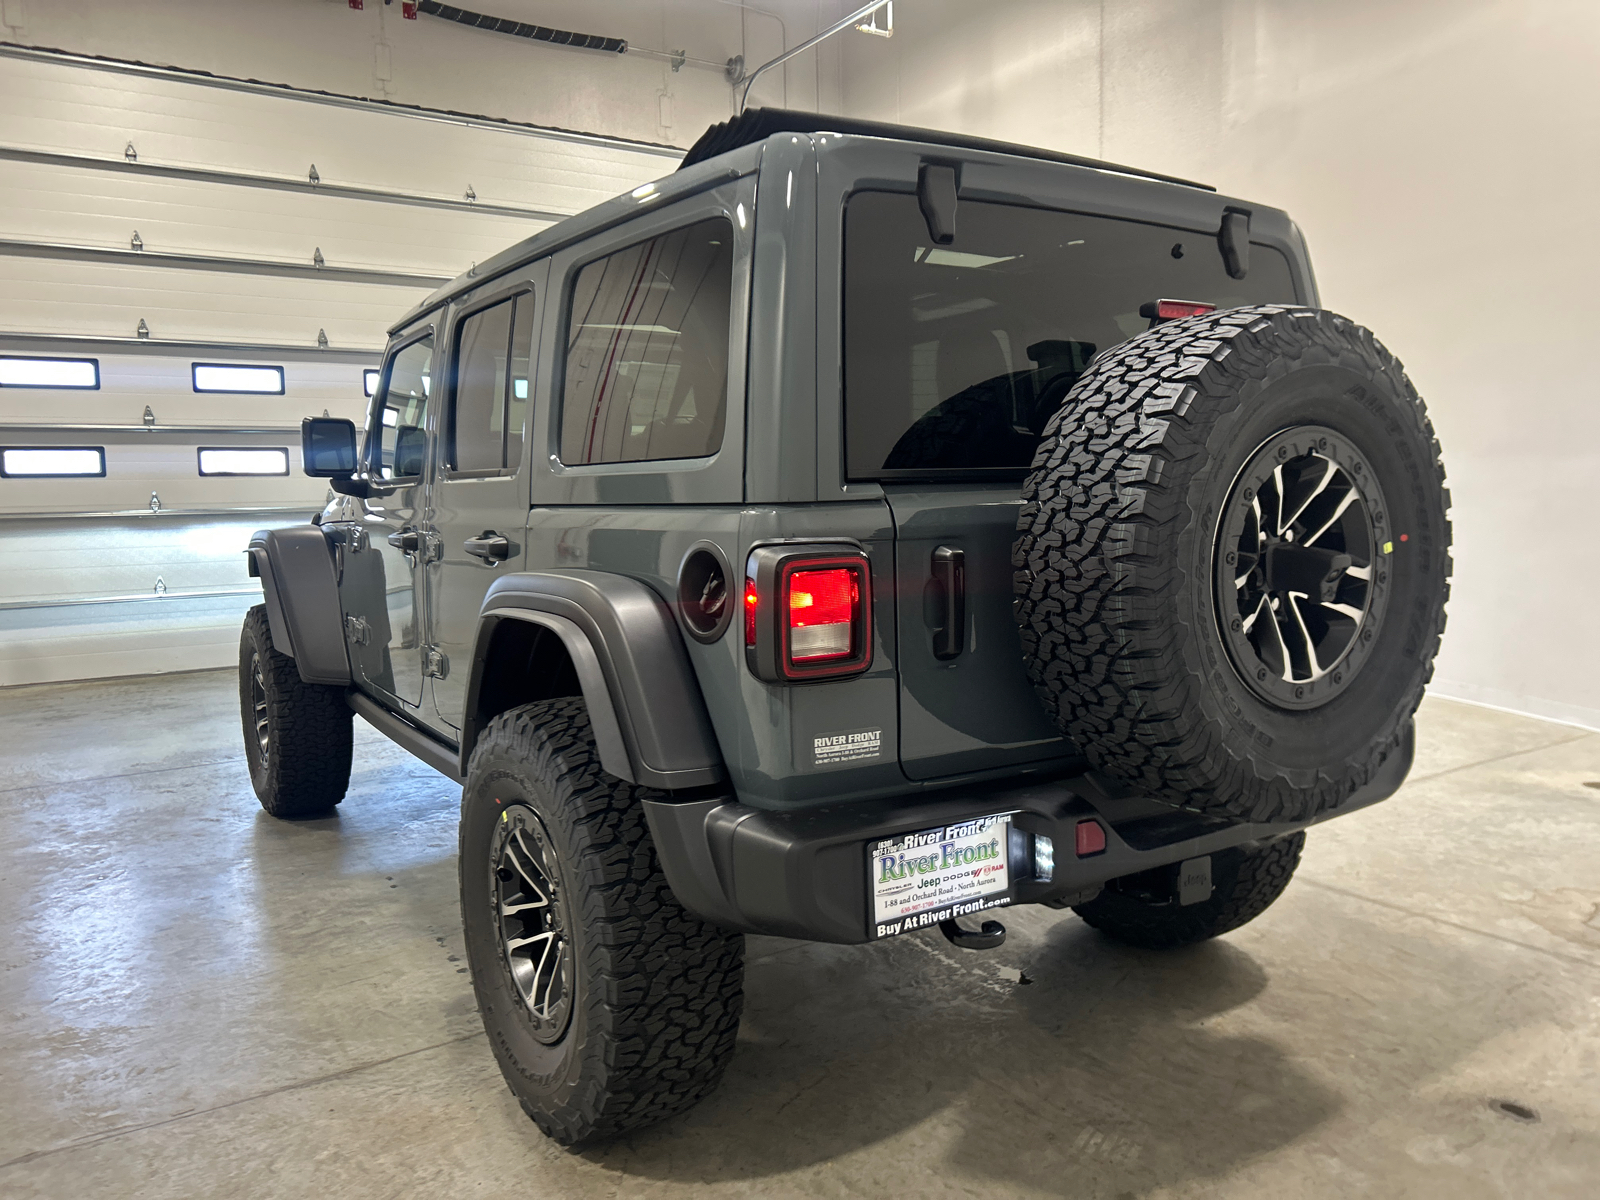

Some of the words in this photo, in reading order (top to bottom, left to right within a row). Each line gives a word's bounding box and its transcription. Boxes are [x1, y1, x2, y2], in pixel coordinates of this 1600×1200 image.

[814, 735, 846, 747] RIVER
[848, 731, 881, 743] FRONT
[904, 831, 942, 849] River
[945, 820, 982, 841] Front
[878, 854, 939, 883] River
[939, 838, 999, 869] Front
[991, 864, 1004, 873] RAM
[917, 876, 941, 889] Jeep
[942, 870, 975, 883] DODGE
[1183, 874, 1206, 887] Jeep
[877, 883, 912, 893] CHRYSLER
[884, 898, 898, 909] I-88
[899, 895, 911, 905] and
[911, 888, 937, 903] Orchard
[937, 884, 954, 897] Road
[957, 881, 976, 892] North
[976, 877, 996, 888] Aurora
[877, 922, 902, 938] Buy
[903, 916, 919, 931] At
[919, 907, 952, 926] River
[952, 897, 1011, 917] Front.com
